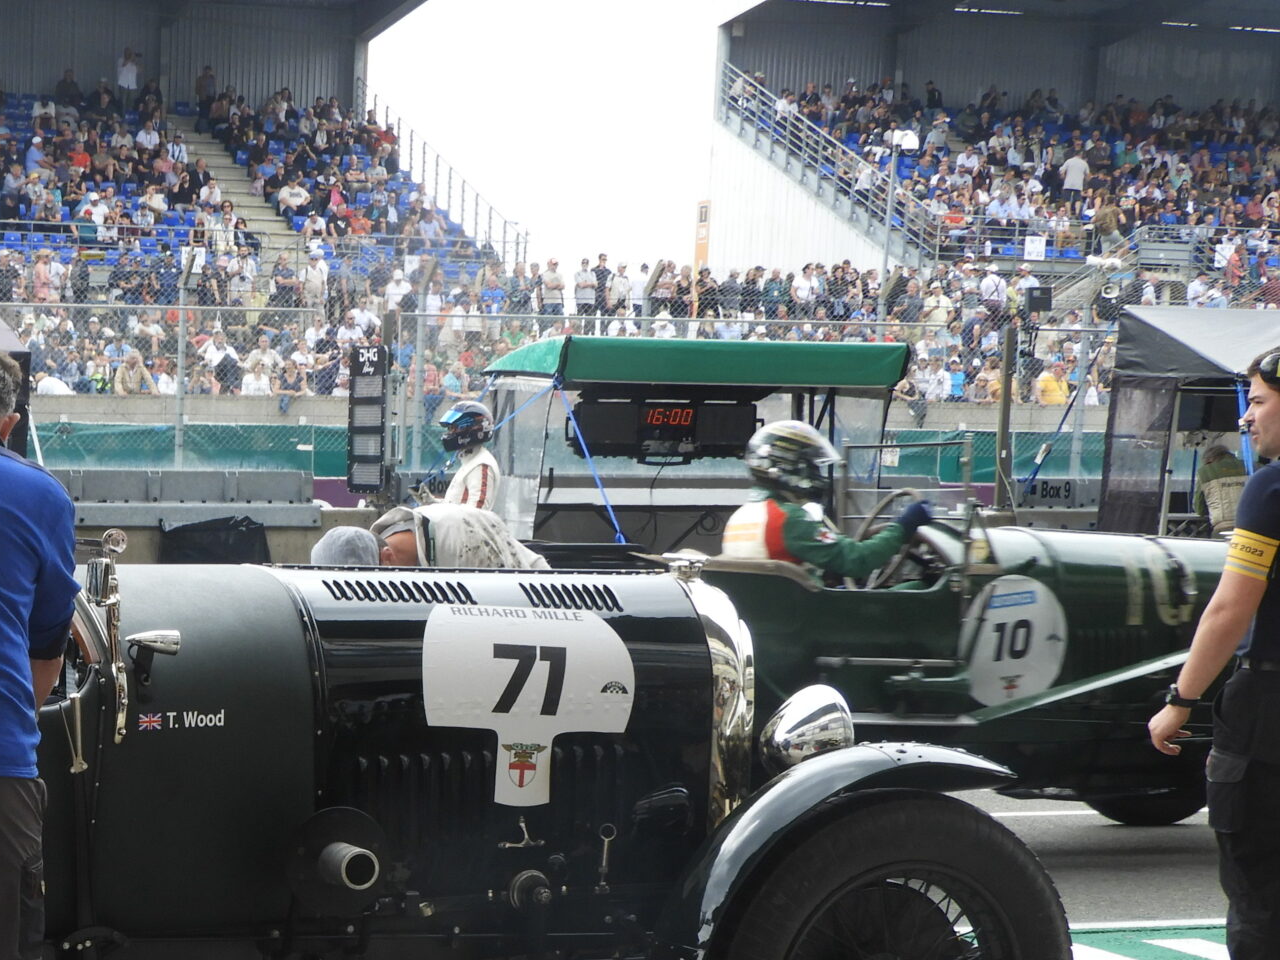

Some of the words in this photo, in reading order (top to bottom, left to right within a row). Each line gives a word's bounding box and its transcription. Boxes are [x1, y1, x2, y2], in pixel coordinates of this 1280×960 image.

[359, 348, 378, 363] DHG
[647, 408, 693, 425] 16:00
[1041, 481, 1061, 499] Box
[1064, 481, 1071, 499] 9
[1239, 544, 1265, 557] 2023
[450, 606, 527, 619] RICHARD
[532, 610, 585, 622] MILLE
[993, 618, 1032, 662] 10
[491, 643, 567, 716] 71
[166, 711, 179, 729] T.
[183, 708, 225, 728] Wood
